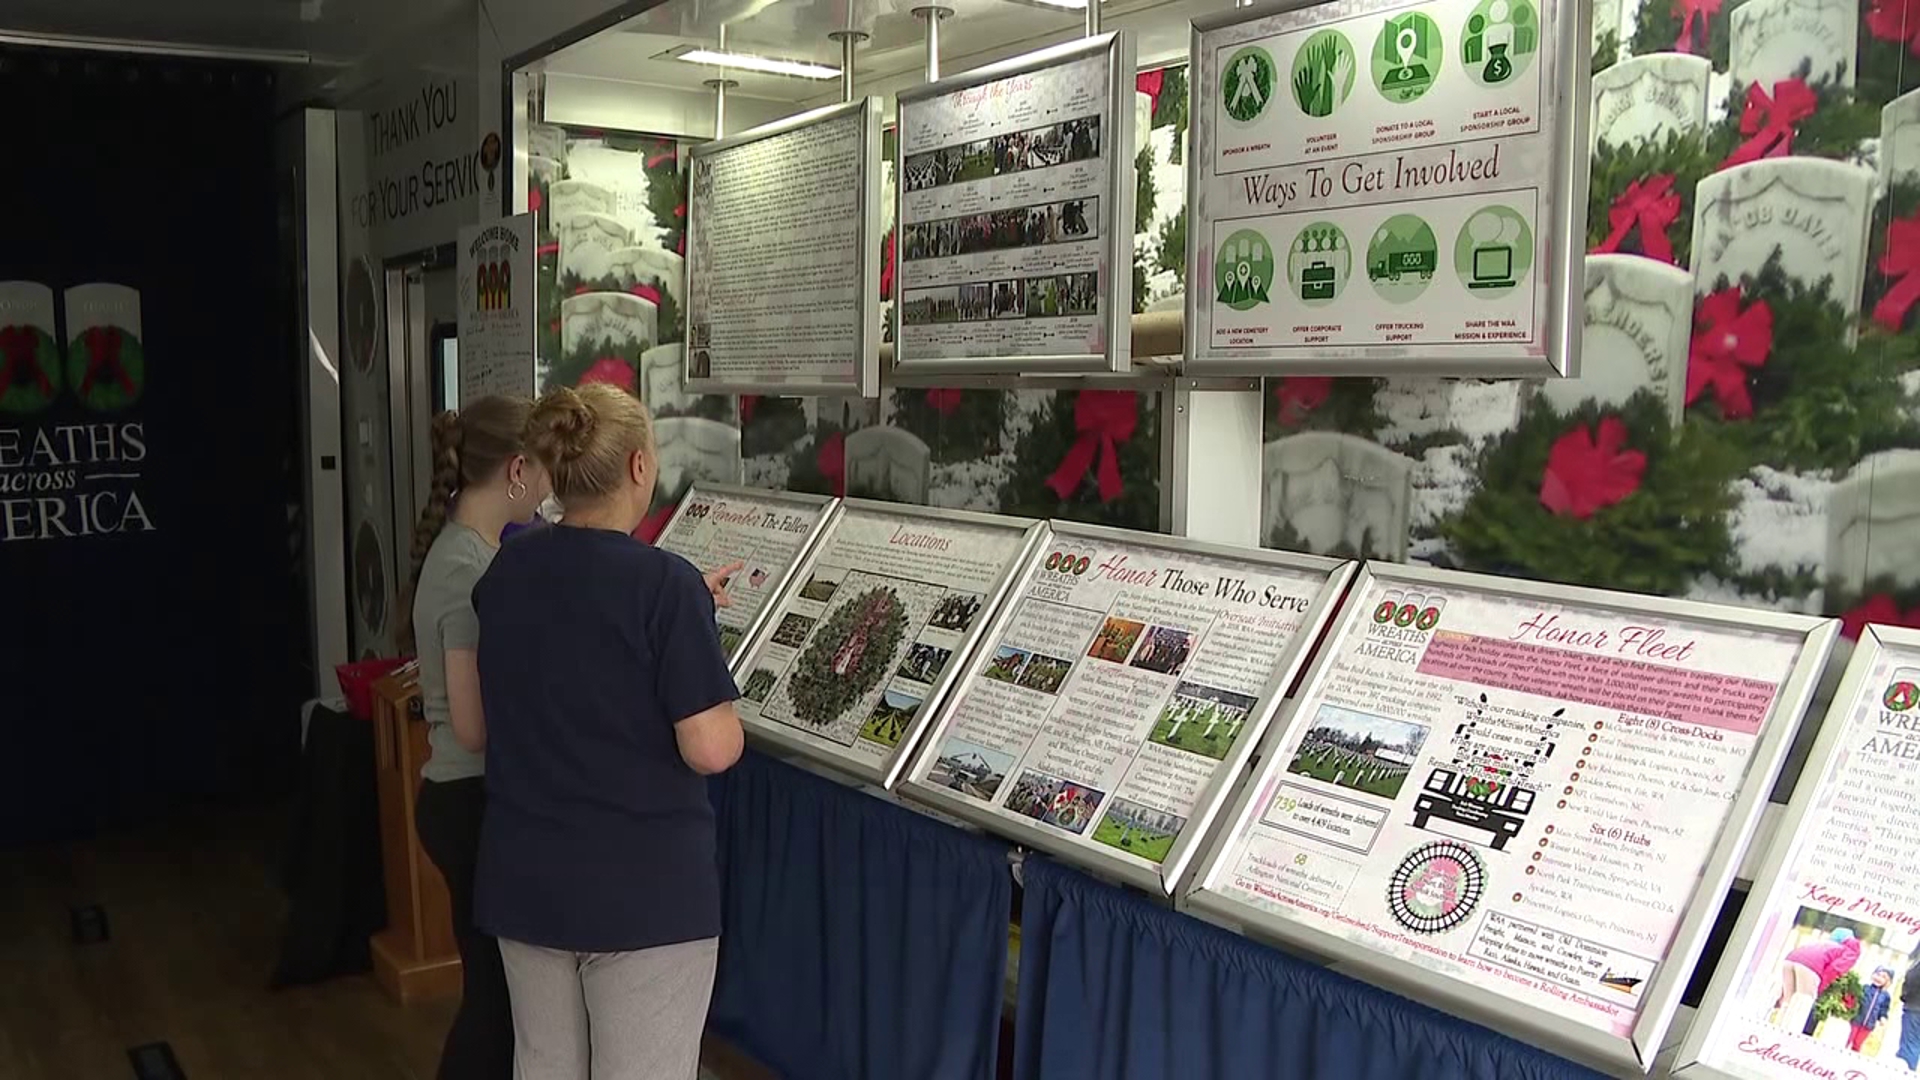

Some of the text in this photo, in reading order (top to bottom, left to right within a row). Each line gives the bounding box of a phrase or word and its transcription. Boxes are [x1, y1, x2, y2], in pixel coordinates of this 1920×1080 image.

[371, 80, 457, 156] THANK YOU
[1472, 109, 1492, 120] START
[1499, 106, 1521, 117] LOCAL
[1375, 122, 1400, 134] DONATE
[1415, 118, 1434, 128] LOCAL
[1459, 117, 1530, 132] SPONSORSHIP GROUP
[1305, 133, 1338, 144] VOLUNTEER
[1371, 129, 1435, 144] SPONSORSHIP GROUP
[1304, 144, 1339, 155] AT AN EVENT
[1243, 144, 1500, 209] Ways To Get Involved
[352, 150, 480, 228] FOR YOUR SERVIC
[1243, 326, 1268, 334] CEMETERY
[1292, 324, 1342, 333] OFFER CORPORATE
[1375, 322, 1424, 331] OFFER TRUCKING
[1464, 319, 1516, 328] SHARE THE WAA
[1229, 337, 1254, 345] LOCATION
[1304, 335, 1329, 343] SUPPORT
[1385, 334, 1412, 342] SUPPORT
[1454, 332, 1481, 340] MISSION
[1486, 330, 1526, 339] EXPERIENCE
[0, 422, 147, 468] EATHS
[0, 490, 157, 541] ERICA
[709, 502, 809, 535] Remember The Fallen
[889, 525, 953, 551] Locations
[1040, 570, 1079, 587] WREATHS
[1088, 554, 1308, 613] Honor Those Who Serve
[1027, 585, 1070, 602] AMERICA
[1219, 608, 1256, 626] Overseas
[1367, 622, 1429, 645] WREATHS
[1510, 612, 1697, 662] Honor Fleet
[1354, 642, 1417, 665] AMERICA
[1647, 665, 1687, 676] themselves
[1689, 672, 1722, 683] traveling
[1505, 708, 1539, 721] trucking
[1539, 714, 1588, 730] companies,
[1617, 714, 1724, 740] Eight (8) Cross-Docks
[1879, 710, 1920, 731] WRE
[1466, 725, 1491, 736] would
[1491, 732, 1512, 741] cease
[1503, 749, 1536, 761] partners
[1862, 737, 1920, 760] AME
[1848, 767, 1897, 782] overcome
[1898, 760, 1917, 772] will
[1843, 778, 1862, 790] and
[1273, 796, 1297, 812] 739
[1837, 791, 1876, 807] forward
[1832, 805, 1878, 821] executive
[1589, 823, 1651, 845] Six (6) Hubs
[1904, 835, 1920, 846] yea
[1821, 830, 1838, 842] the
[1874, 841, 1899, 857] story
[1903, 848, 1916, 860] of
[1294, 853, 1307, 865] 68
[1815, 844, 1920, 875] stories of many oth
[1834, 861, 1856, 875] with
[1863, 869, 1907, 888] purpose
[1825, 874, 1899, 902] chosen to keep
[1477, 961, 1493, 972] how
[1503, 970, 1532, 985] become
[1540, 983, 1568, 999] Rolling
[1569, 993, 1619, 1016] Ambassador
[1738, 1034, 1838, 1080] Education
